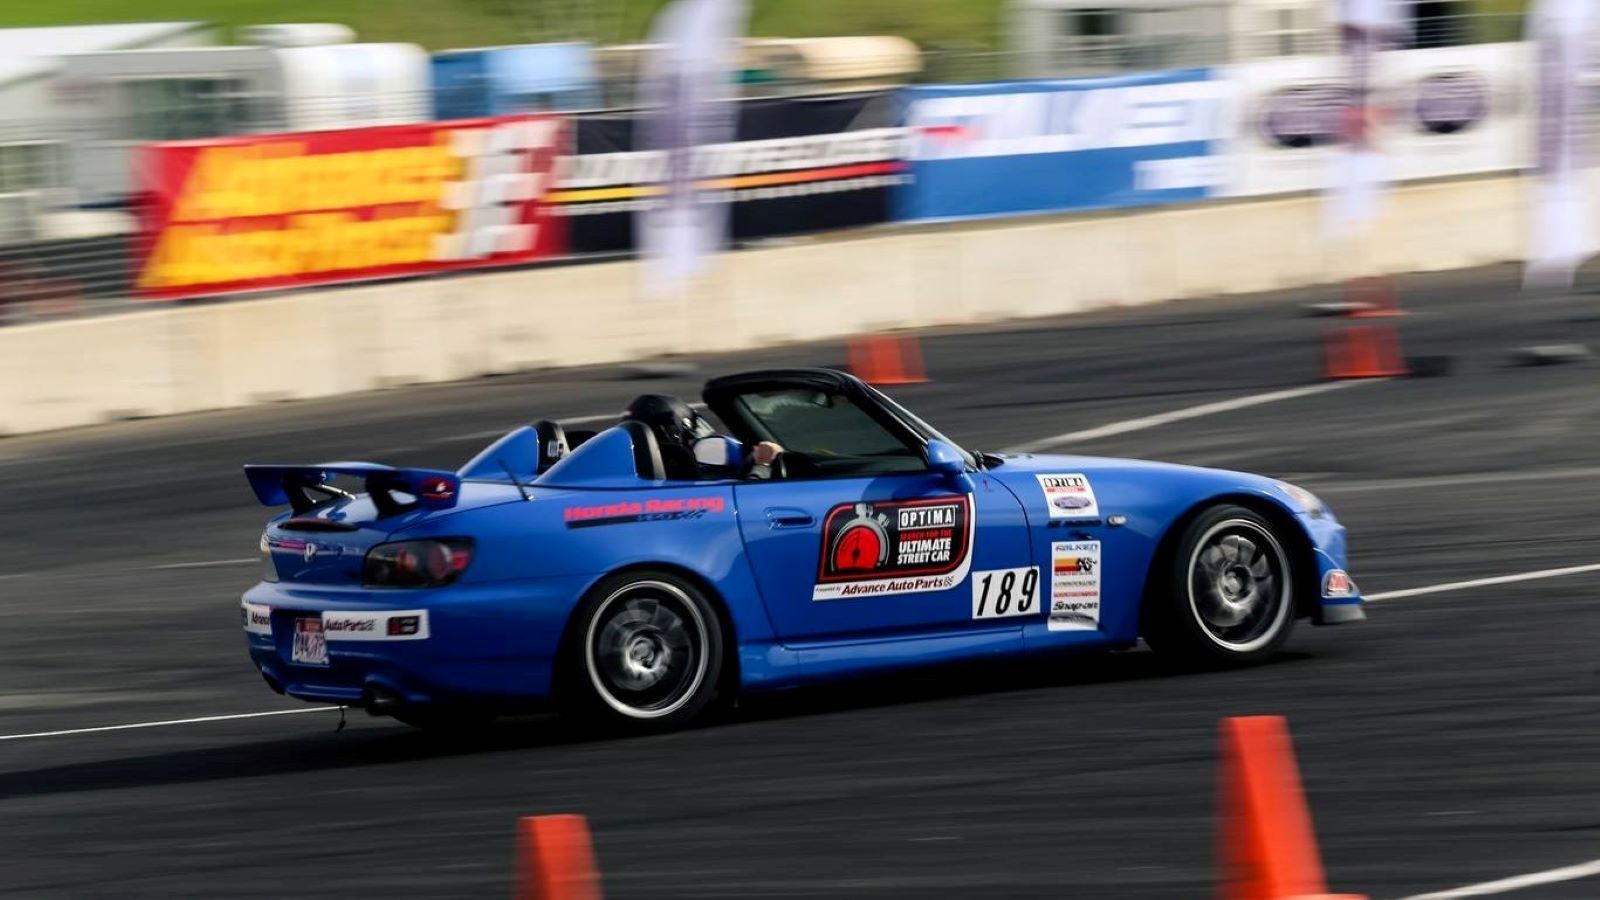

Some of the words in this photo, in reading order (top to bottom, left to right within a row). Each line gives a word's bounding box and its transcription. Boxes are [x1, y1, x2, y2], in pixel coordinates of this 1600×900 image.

[564, 503, 642, 521] Honda
[646, 497, 724, 513] Racing
[901, 509, 952, 526] OPTIMA
[899, 537, 951, 553] ULTIMATE
[897, 552, 930, 565] STREET
[931, 550, 950, 562] CAR
[842, 583, 886, 596] Advance
[977, 569, 1038, 616] 189
